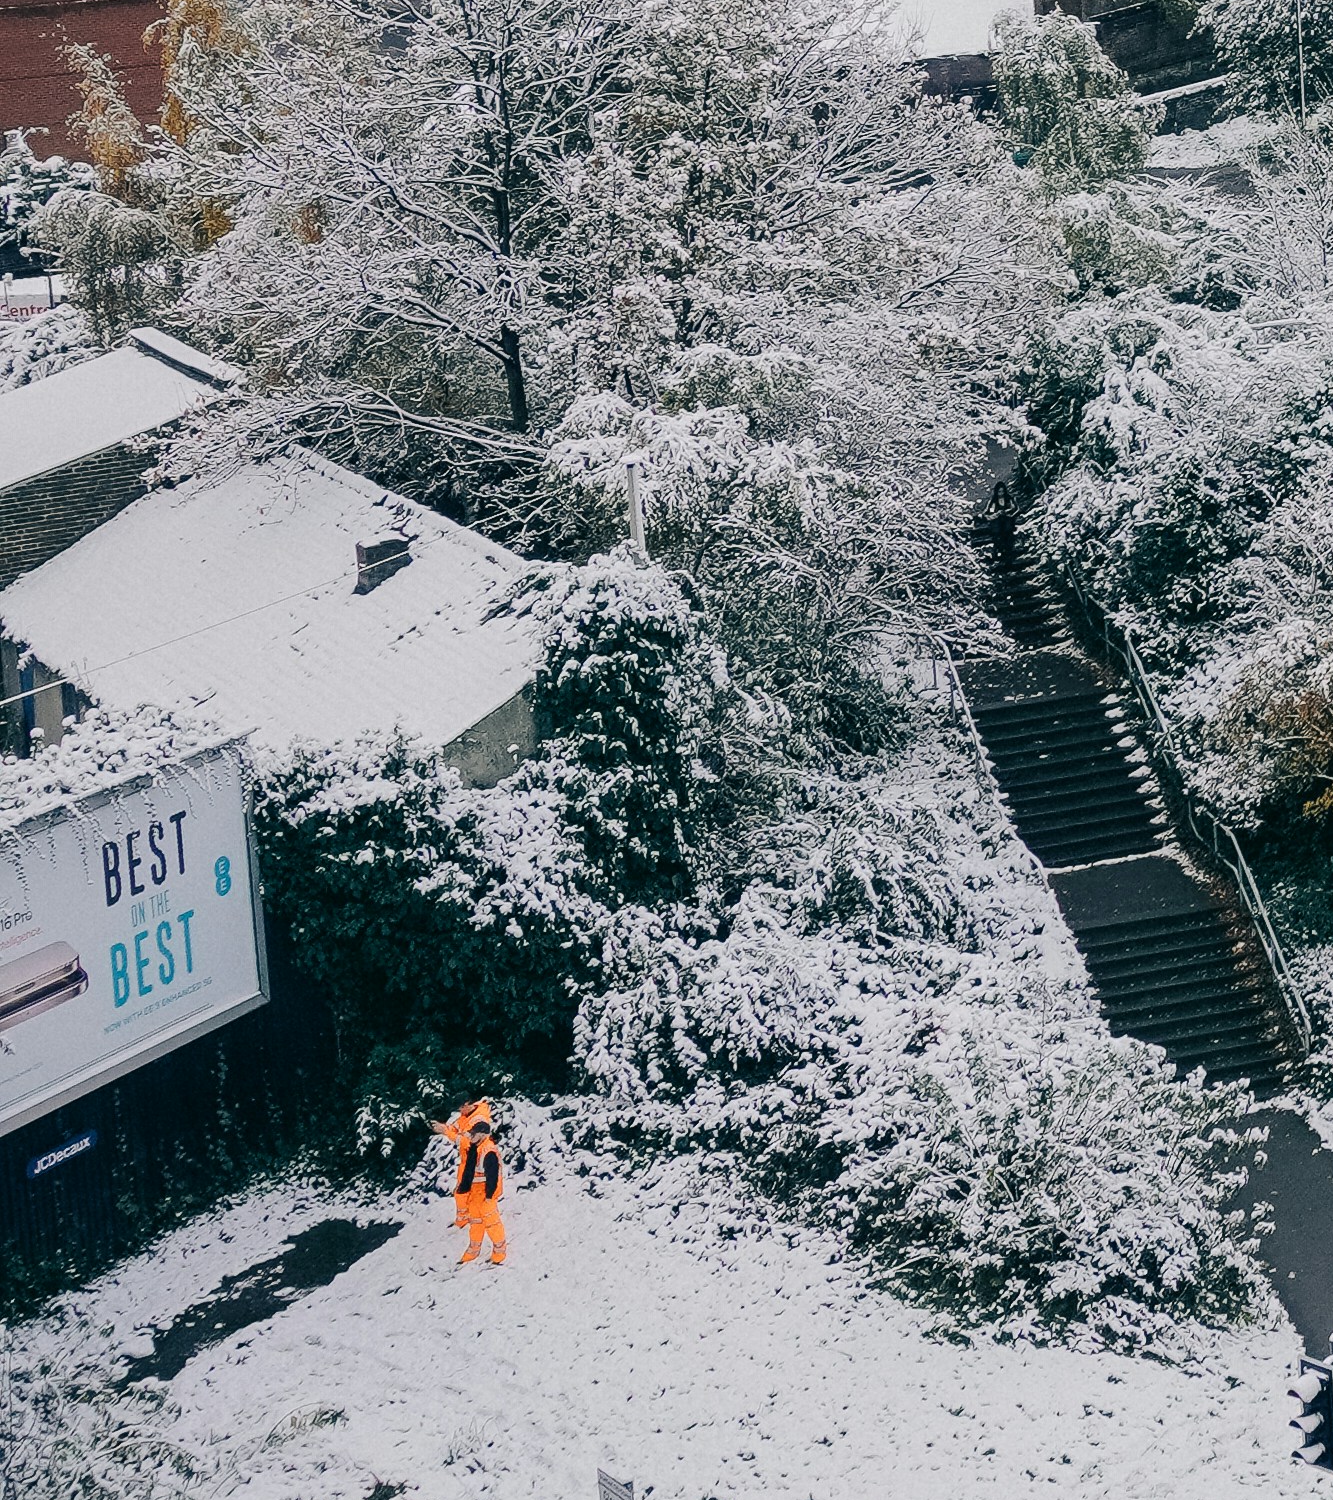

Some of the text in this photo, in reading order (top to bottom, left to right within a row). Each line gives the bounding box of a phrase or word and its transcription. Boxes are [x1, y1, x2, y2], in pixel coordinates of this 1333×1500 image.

[102, 809, 187, 908] BEST
[14, 910, 33, 926] Pro
[131, 889, 171, 928] ON THE
[110, 909, 195, 1008] BEST
[33, 1135, 91, 1174] JCDecaux
